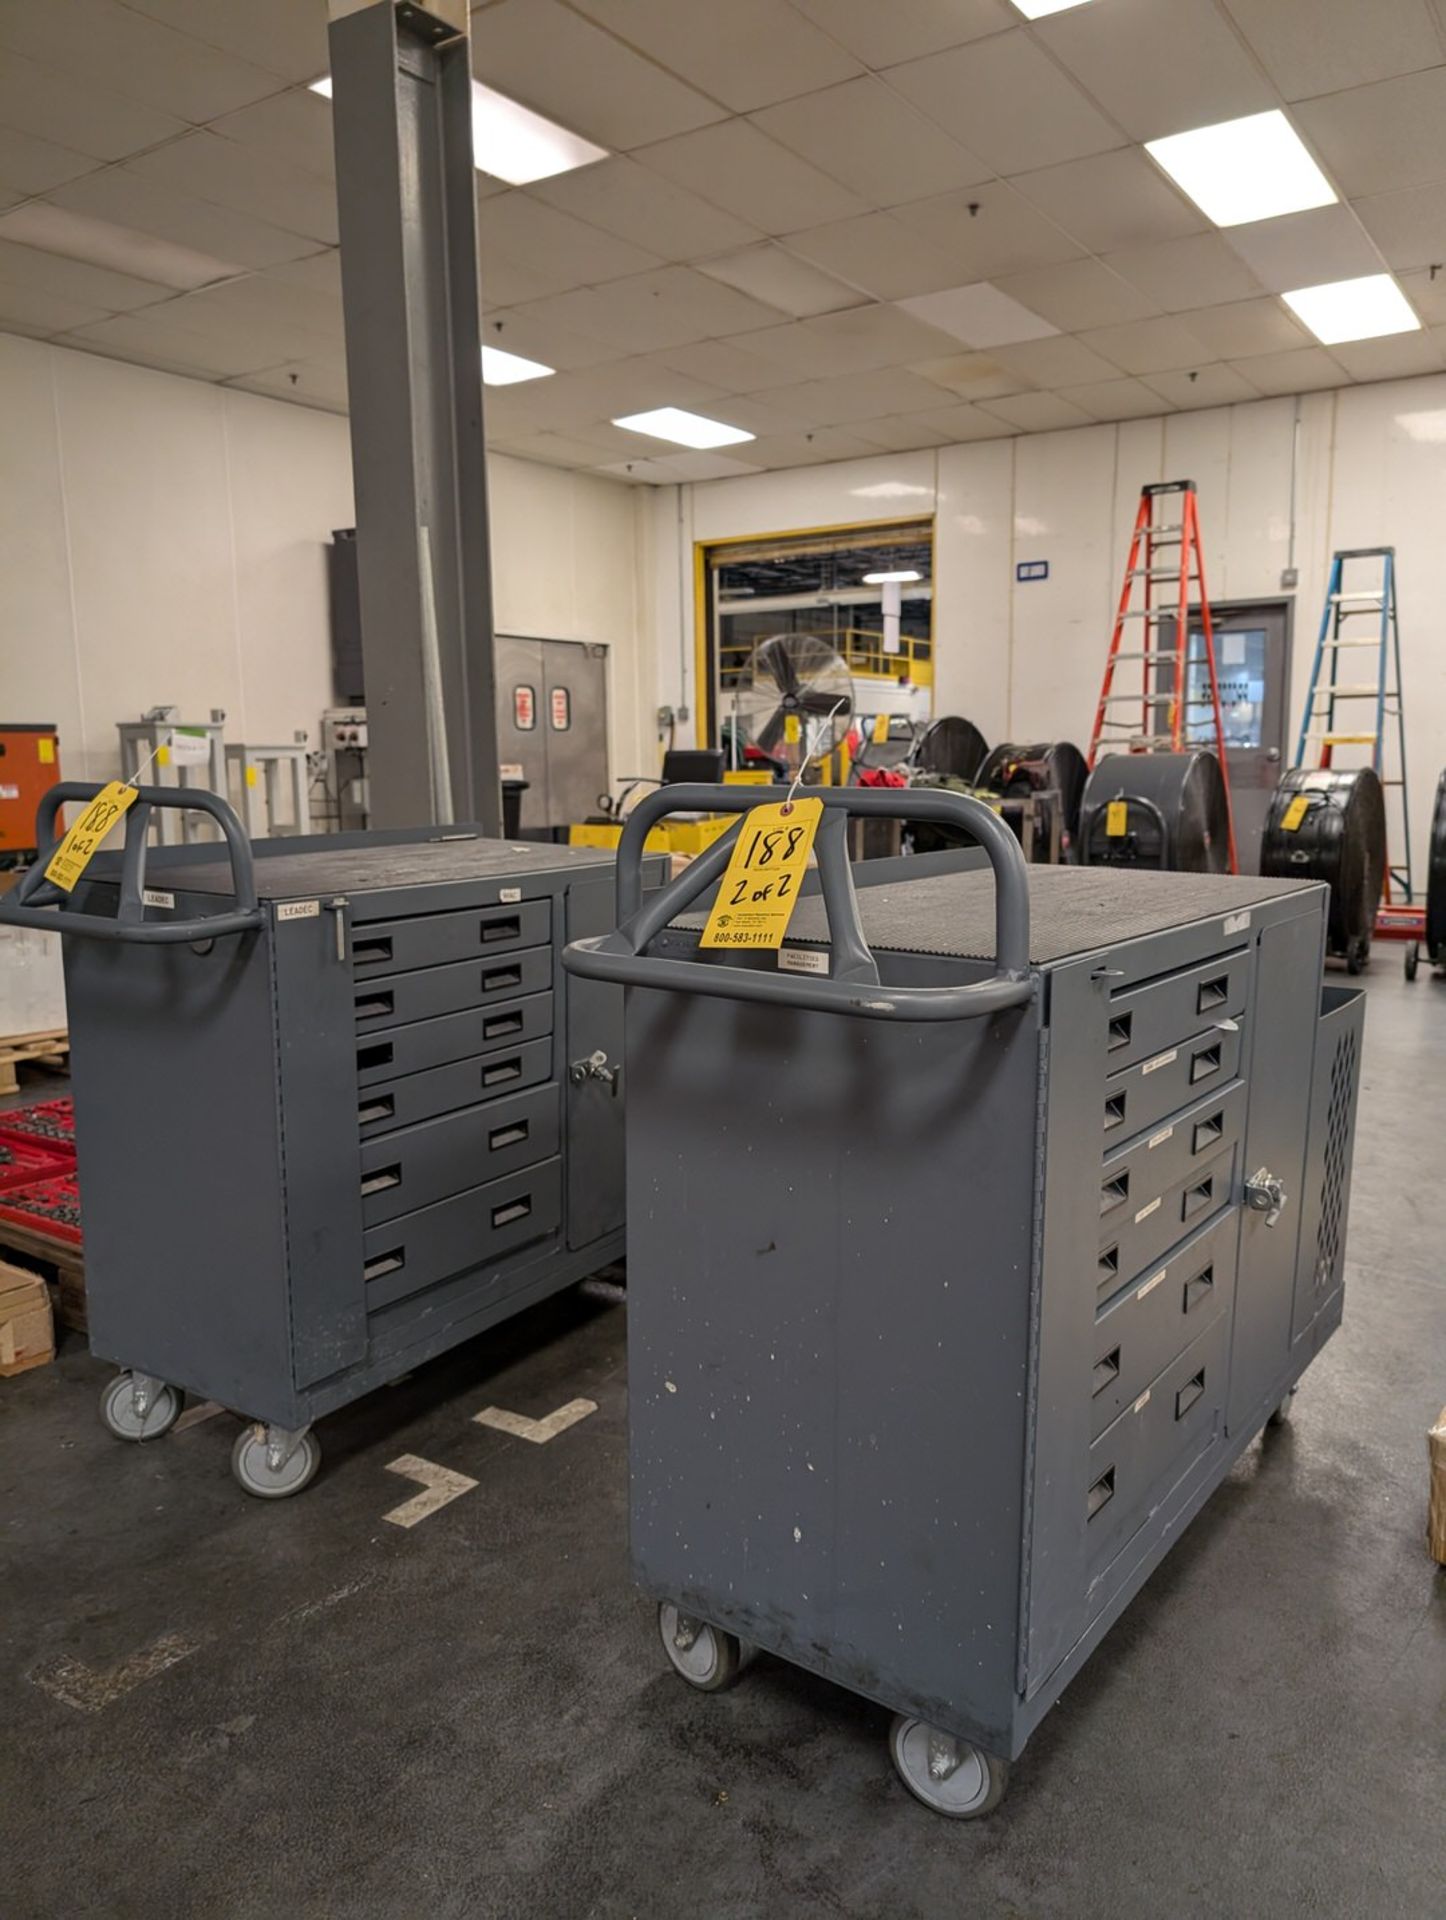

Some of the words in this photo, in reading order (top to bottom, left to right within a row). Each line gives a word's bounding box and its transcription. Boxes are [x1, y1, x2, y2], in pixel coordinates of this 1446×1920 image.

[80, 801, 118, 833] 188
[83, 838, 93, 855] 2
[744, 827, 805, 869] 188
[730, 879, 748, 905] 2
[777, 873, 792, 897] 2
[284, 903, 313, 916] LEADEC
[713, 932, 774, 943] 800-583-1111
